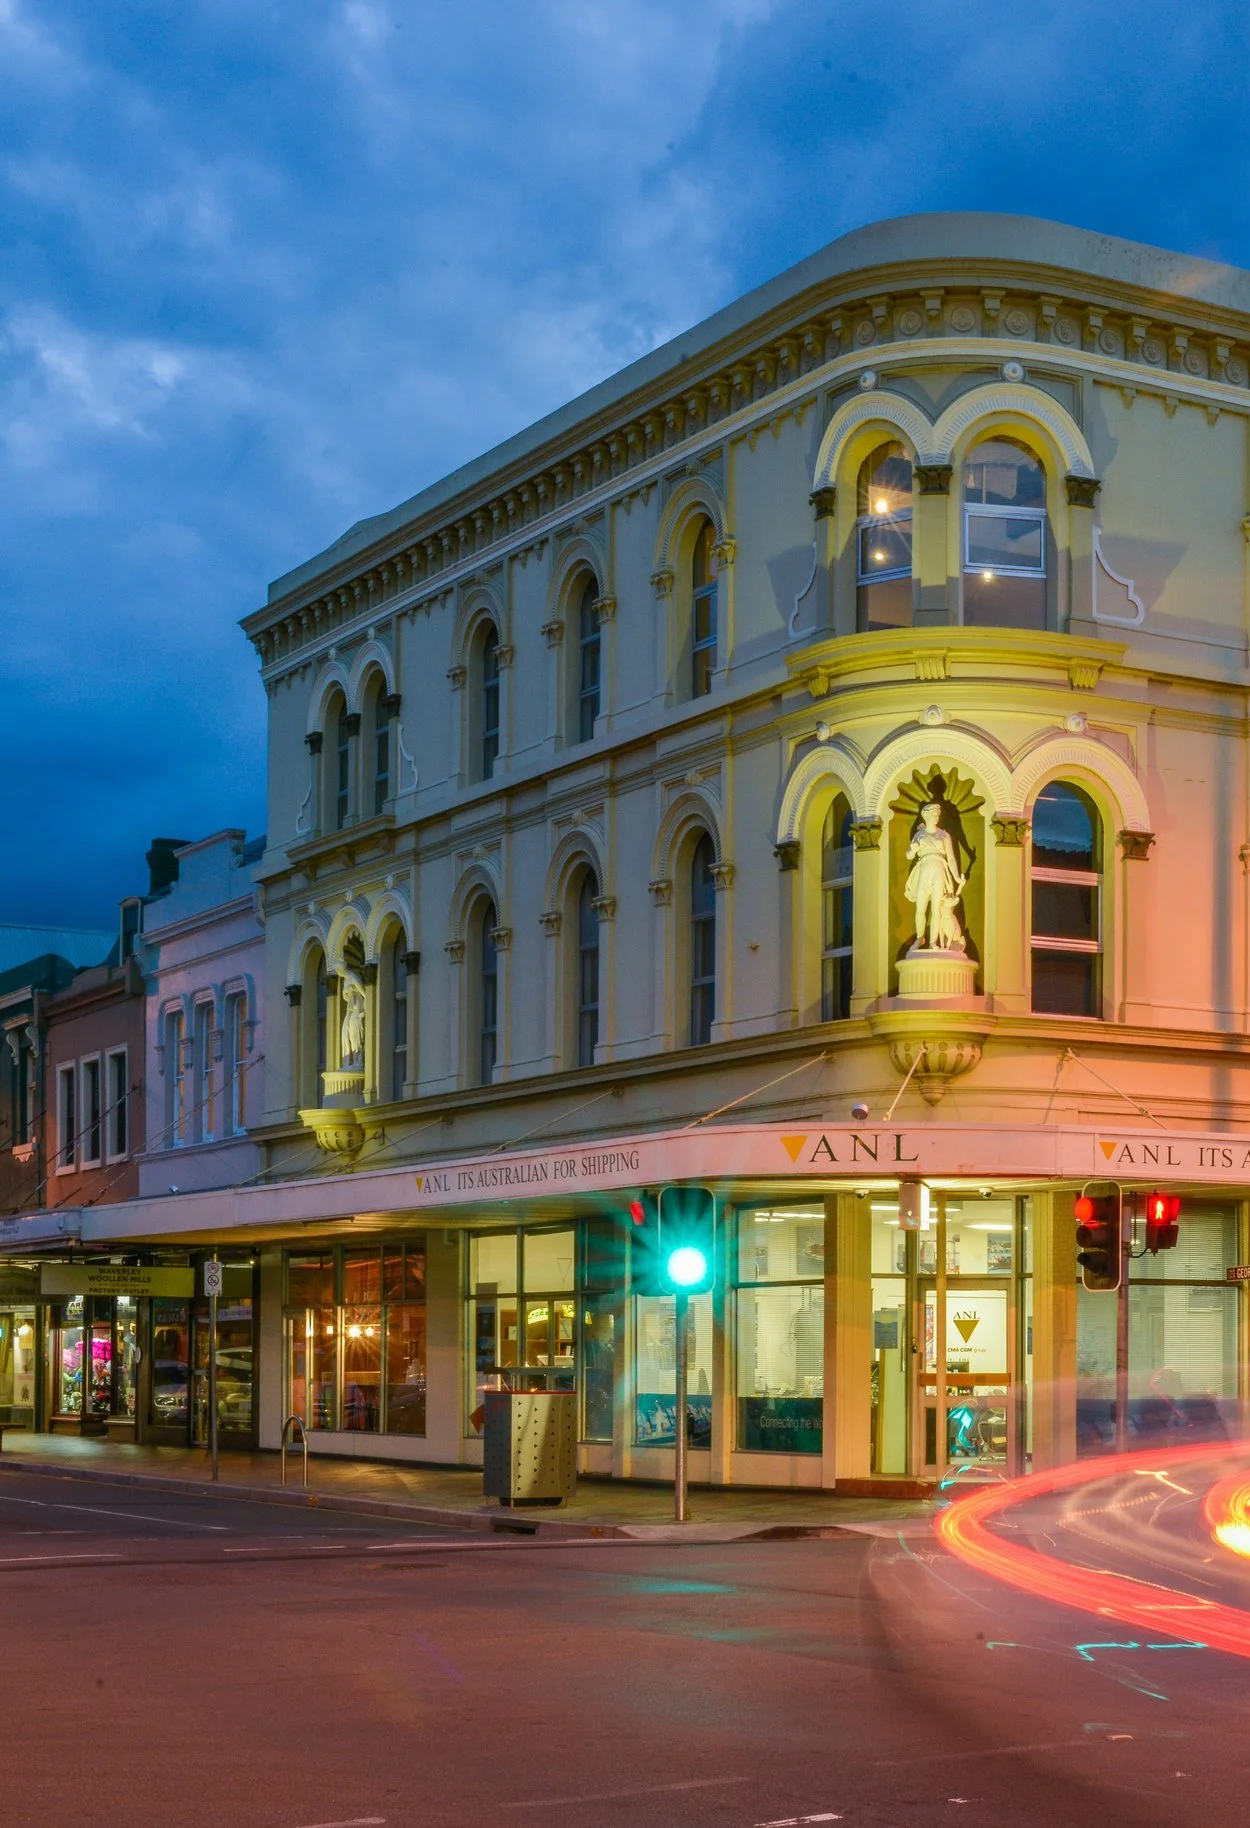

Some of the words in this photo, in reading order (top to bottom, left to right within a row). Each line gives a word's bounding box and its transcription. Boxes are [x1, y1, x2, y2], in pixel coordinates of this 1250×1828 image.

[808, 1133, 920, 1163] ANL
[1117, 1143, 1182, 1166] ANL
[1198, 1147, 1233, 1168] ITS
[423, 1174, 451, 1194] ANL
[457, 1171, 474, 1190] ITS
[477, 1162, 549, 1188] AUSTRALIAN
[553, 1158, 577, 1180] FOR
[581, 1150, 640, 1176] SHIPPING
[97, 1267, 142, 1276] WAVERLEY
[953, 1311, 980, 1320] ANL
[760, 1416, 799, 1431] Connecting
